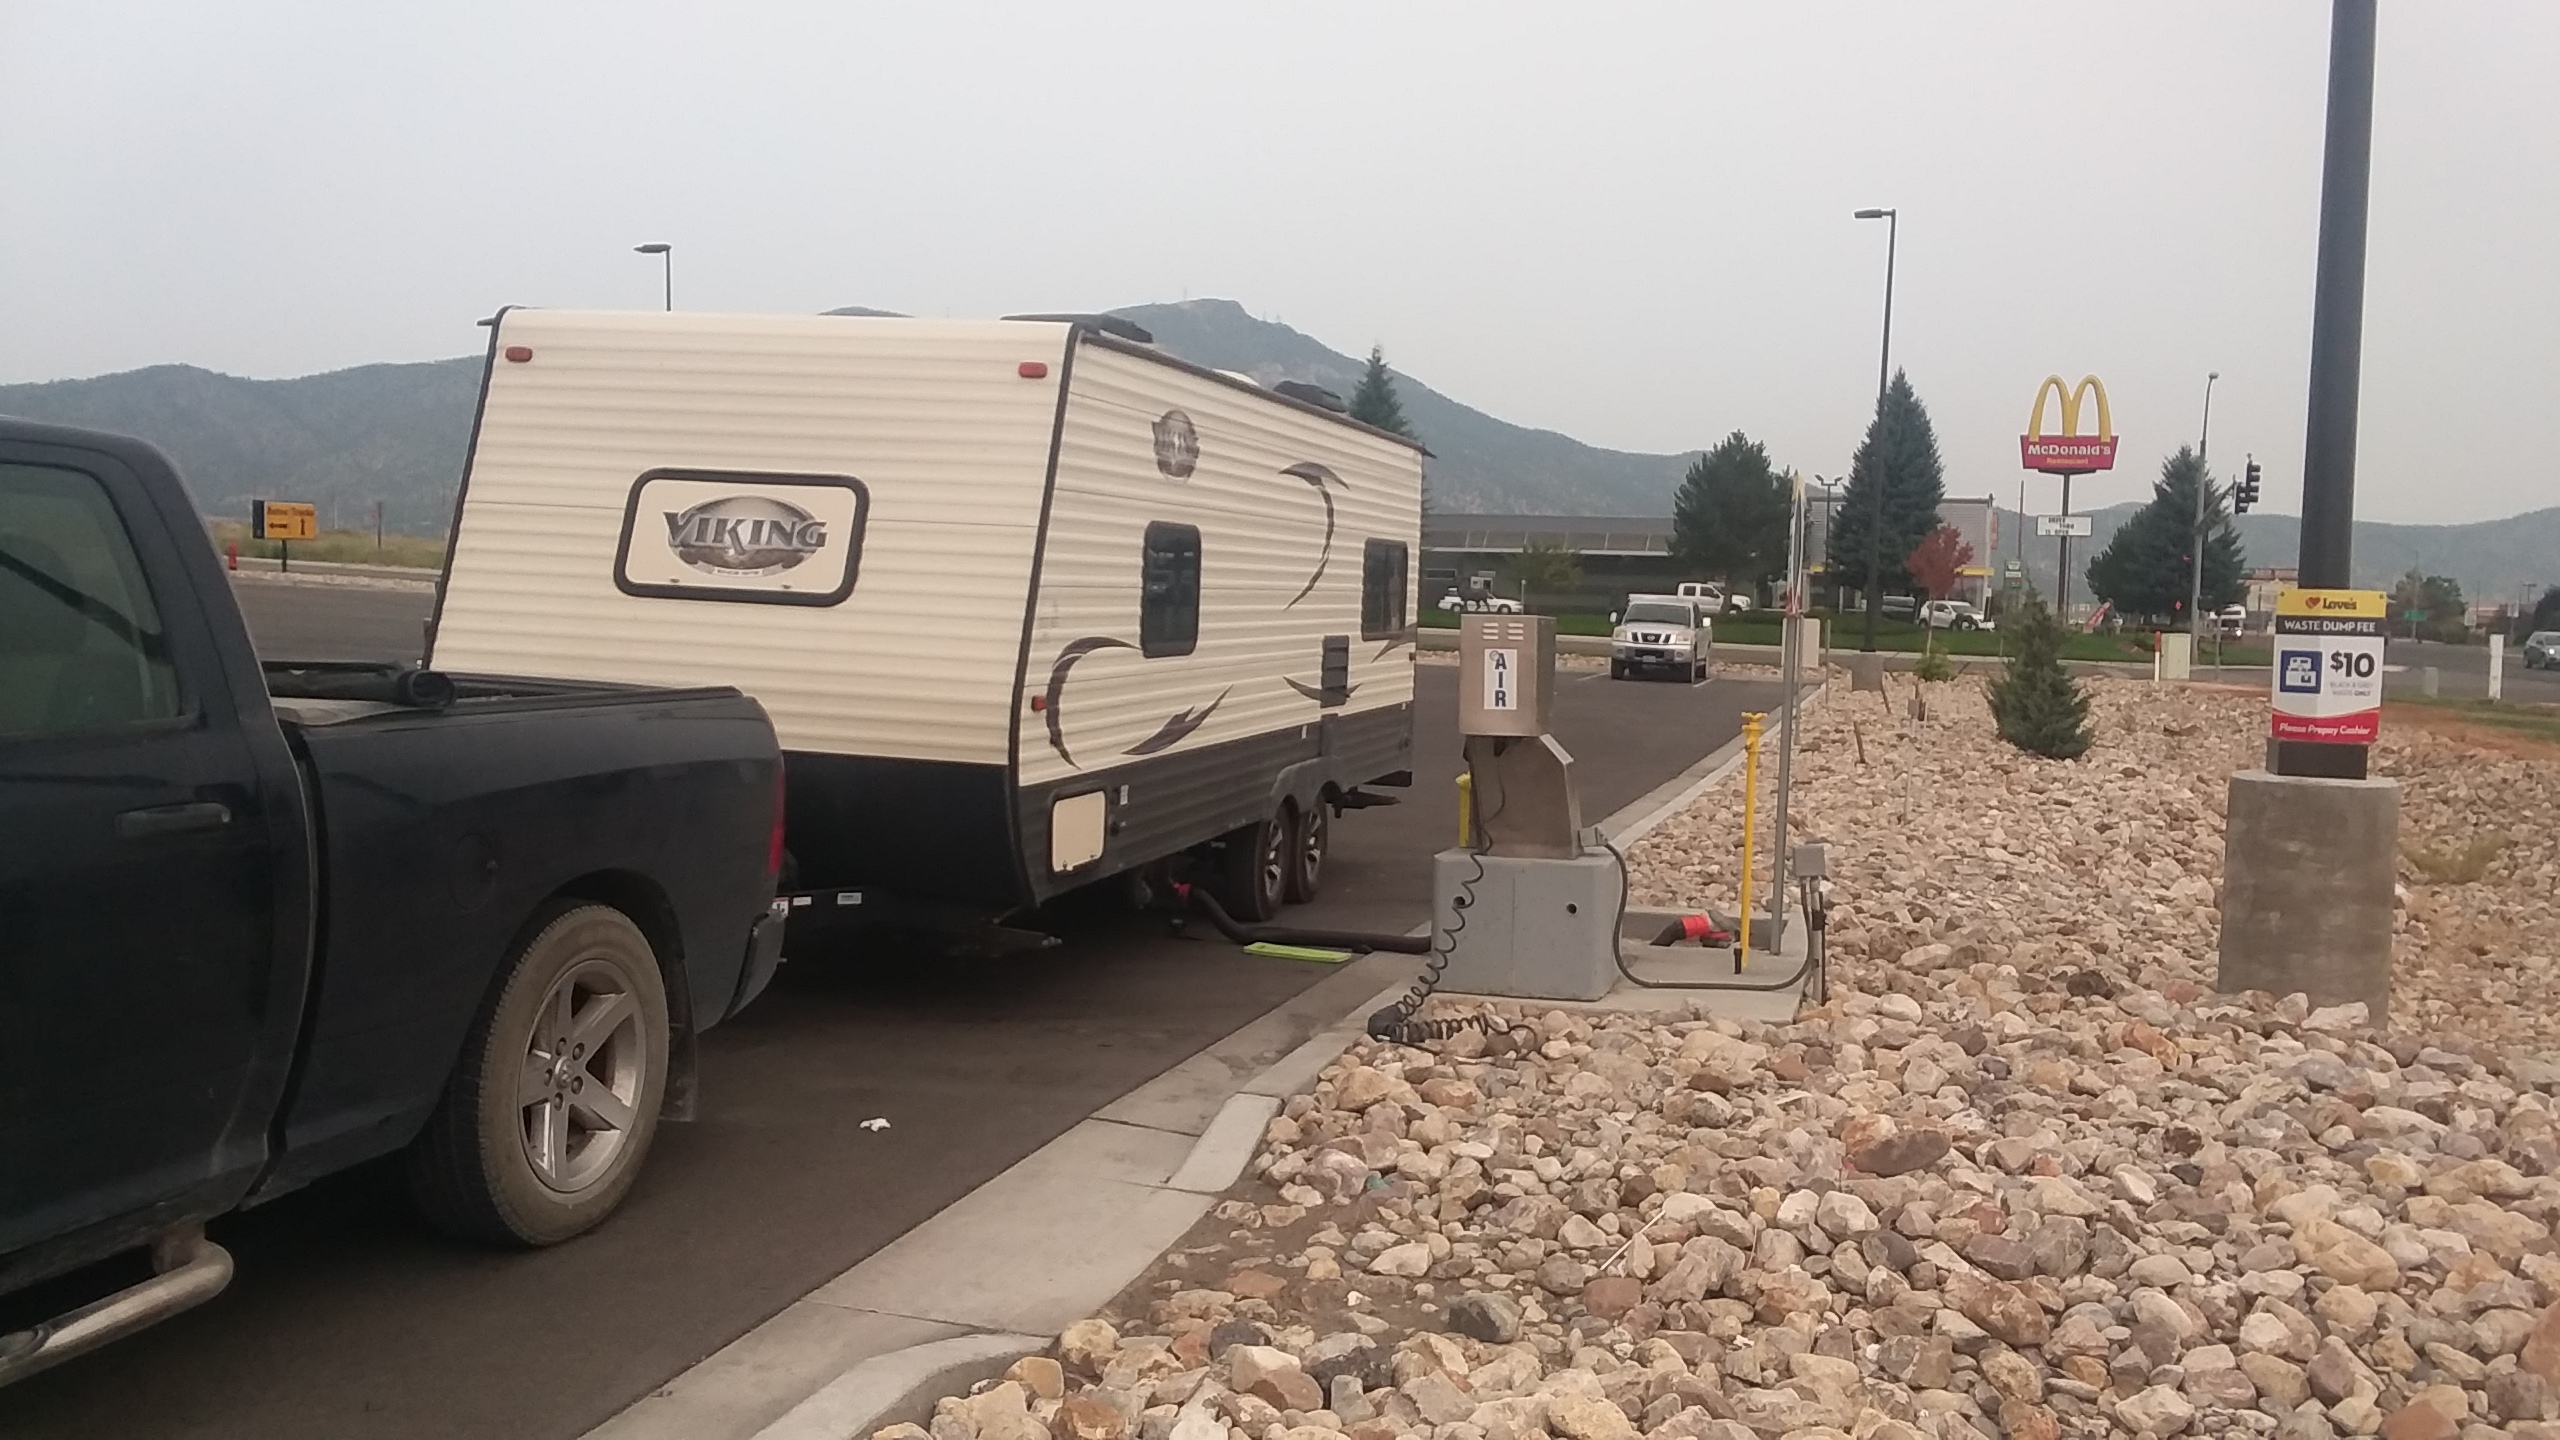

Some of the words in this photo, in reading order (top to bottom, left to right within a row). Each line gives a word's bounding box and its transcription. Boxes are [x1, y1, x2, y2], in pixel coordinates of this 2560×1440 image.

[2027, 444, 2111, 455] McDonald's
[663, 511, 828, 555] VIKING
[2322, 597, 2357, 610] Love's
[2284, 620, 2321, 631] WASTE
[2322, 620, 2355, 632] DUMP
[2356, 621, 2376, 633] FEE
[2330, 650, 2375, 678] $10
[1494, 652, 1507, 708] AIR
[2279, 722, 2307, 733] Please
[2307, 724, 2338, 737] Prepay
[2339, 725, 2371, 735] Cashier
